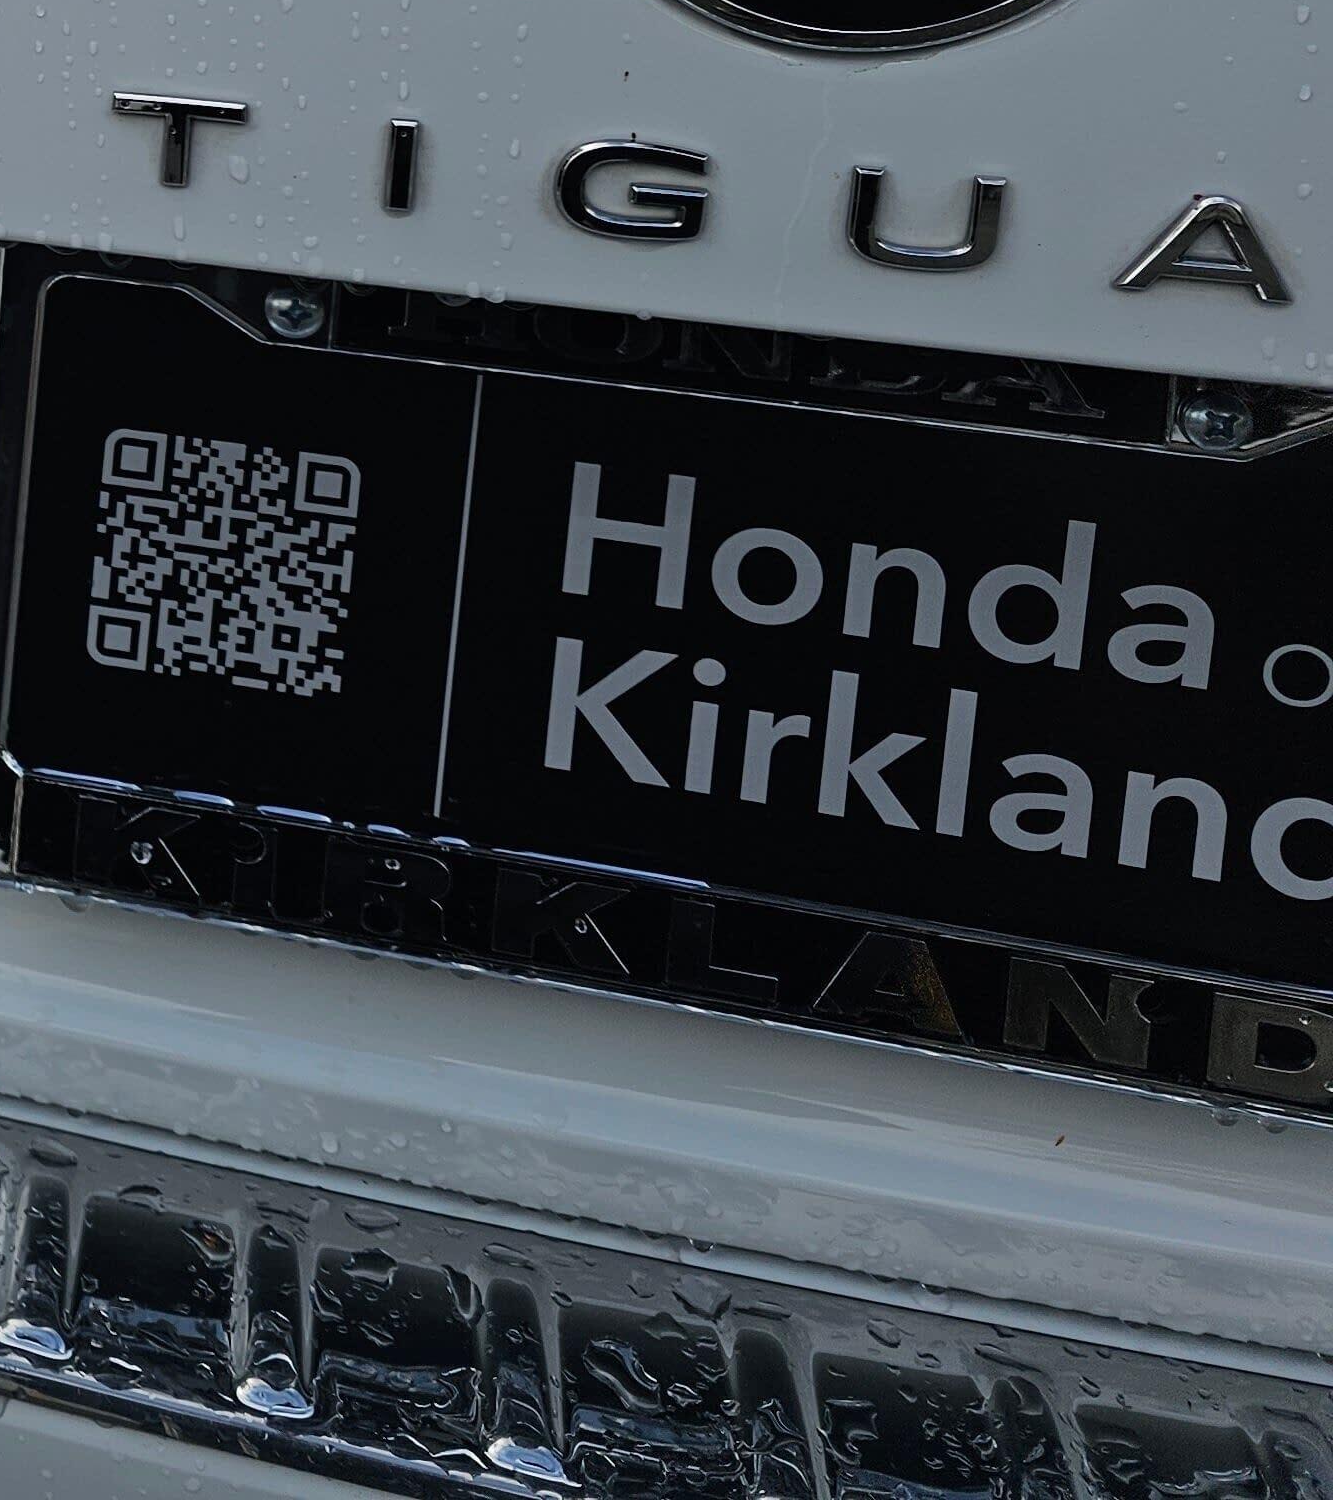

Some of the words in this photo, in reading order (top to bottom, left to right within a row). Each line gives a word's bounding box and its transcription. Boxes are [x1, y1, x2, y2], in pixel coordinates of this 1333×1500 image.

[111, 89, 1295, 306] TIGUA
[561, 460, 1217, 692] Honda
[69, 793, 1333, 1103] KIRKLAND
